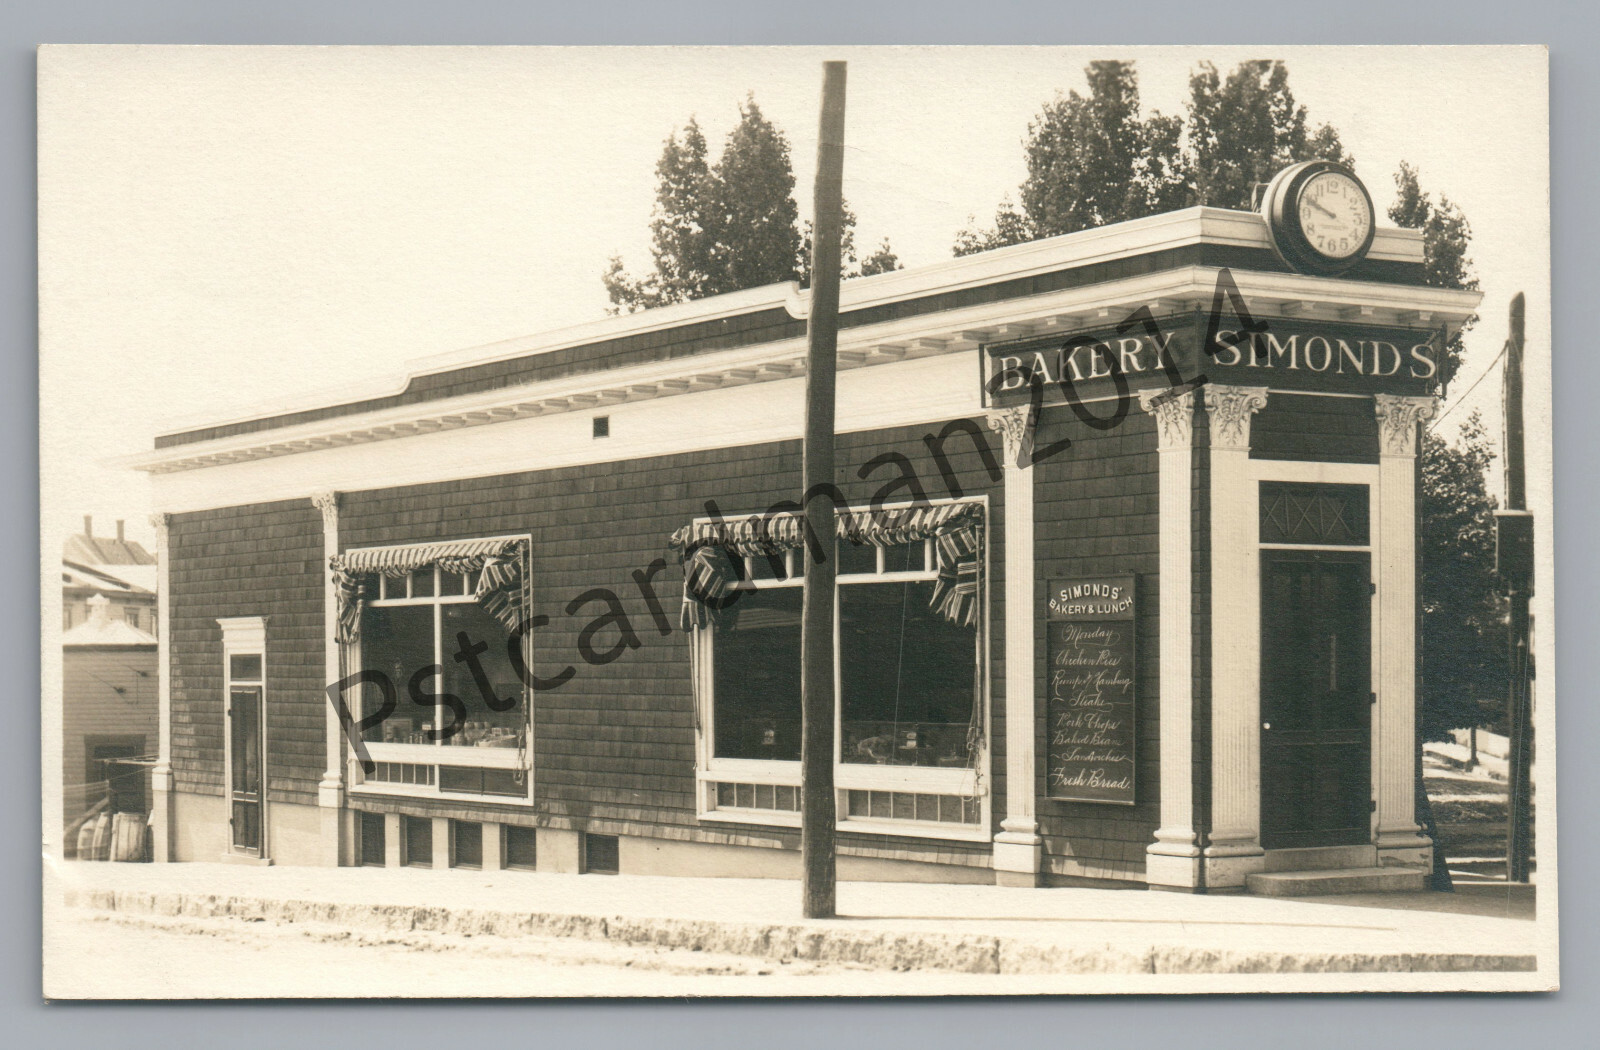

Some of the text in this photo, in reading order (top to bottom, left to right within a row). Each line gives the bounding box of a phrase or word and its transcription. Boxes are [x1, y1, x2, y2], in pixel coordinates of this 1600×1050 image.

[1316, 184, 1324, 197] 11
[1326, 180, 1339, 194] 12
[1350, 197, 1359, 211] 2
[1353, 213, 1363, 226] 3
[1306, 223, 1315, 236] 8
[1349, 229, 1359, 241] 4
[1317, 236, 1326, 248] 7
[1327, 240, 1337, 253] 6
[1340, 238, 1349, 251] 5
[999, 329, 1437, 391] BAKERY SIMONDS
[1048, 596, 1133, 614] BAKERY & LUNCH
[1062, 624, 1120, 649] Monday
[1055, 649, 1121, 666] Chicken Pies
[1051, 669, 1081, 696] Rump
[1094, 669, 1133, 694] Hamburg
[1069, 689, 1108, 709] Steaks
[1056, 712, 1121, 733] Pork Chops
[1053, 729, 1089, 745] Baked
[1061, 747, 1126, 762] Sandwiches
[1049, 767, 1087, 786] Fresh
